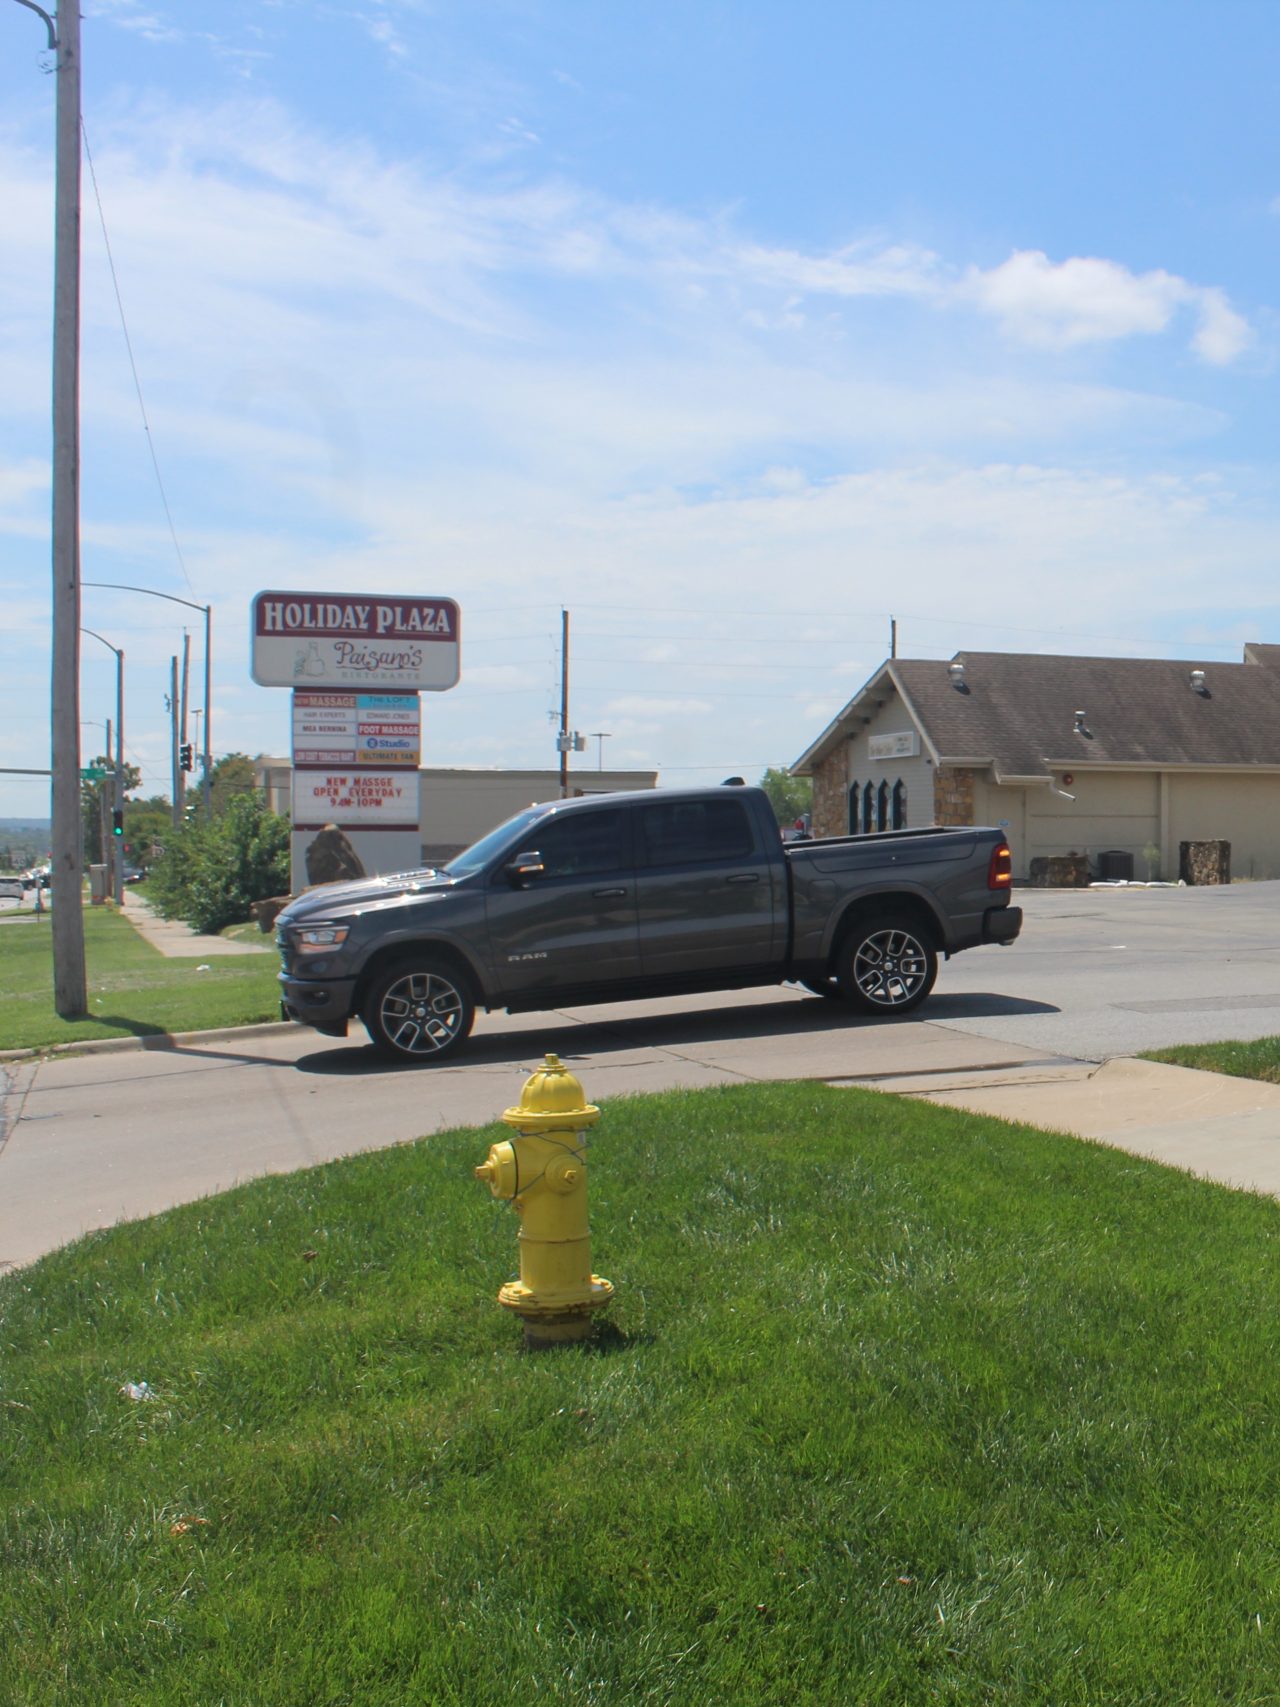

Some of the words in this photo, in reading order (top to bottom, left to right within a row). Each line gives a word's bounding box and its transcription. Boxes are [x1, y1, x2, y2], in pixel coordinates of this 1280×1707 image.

[263, 601, 370, 631] HOLIDAY
[376, 605, 450, 634] PLAZA
[333, 641, 423, 671] Paisano's
[342, 671, 421, 680] RISTORANTE
[309, 696, 355, 707] MASSAGE
[359, 725, 380, 734] FOOT
[381, 725, 419, 735] MASSAGE
[379, 739, 410, 748] Studio
[326, 776, 348, 786] NEW
[353, 777, 394, 787] MASSGE
[313, 787, 339, 797] OPEN
[348, 787, 402, 798] EVERYDAY
[508, 952, 547, 961] RAM
